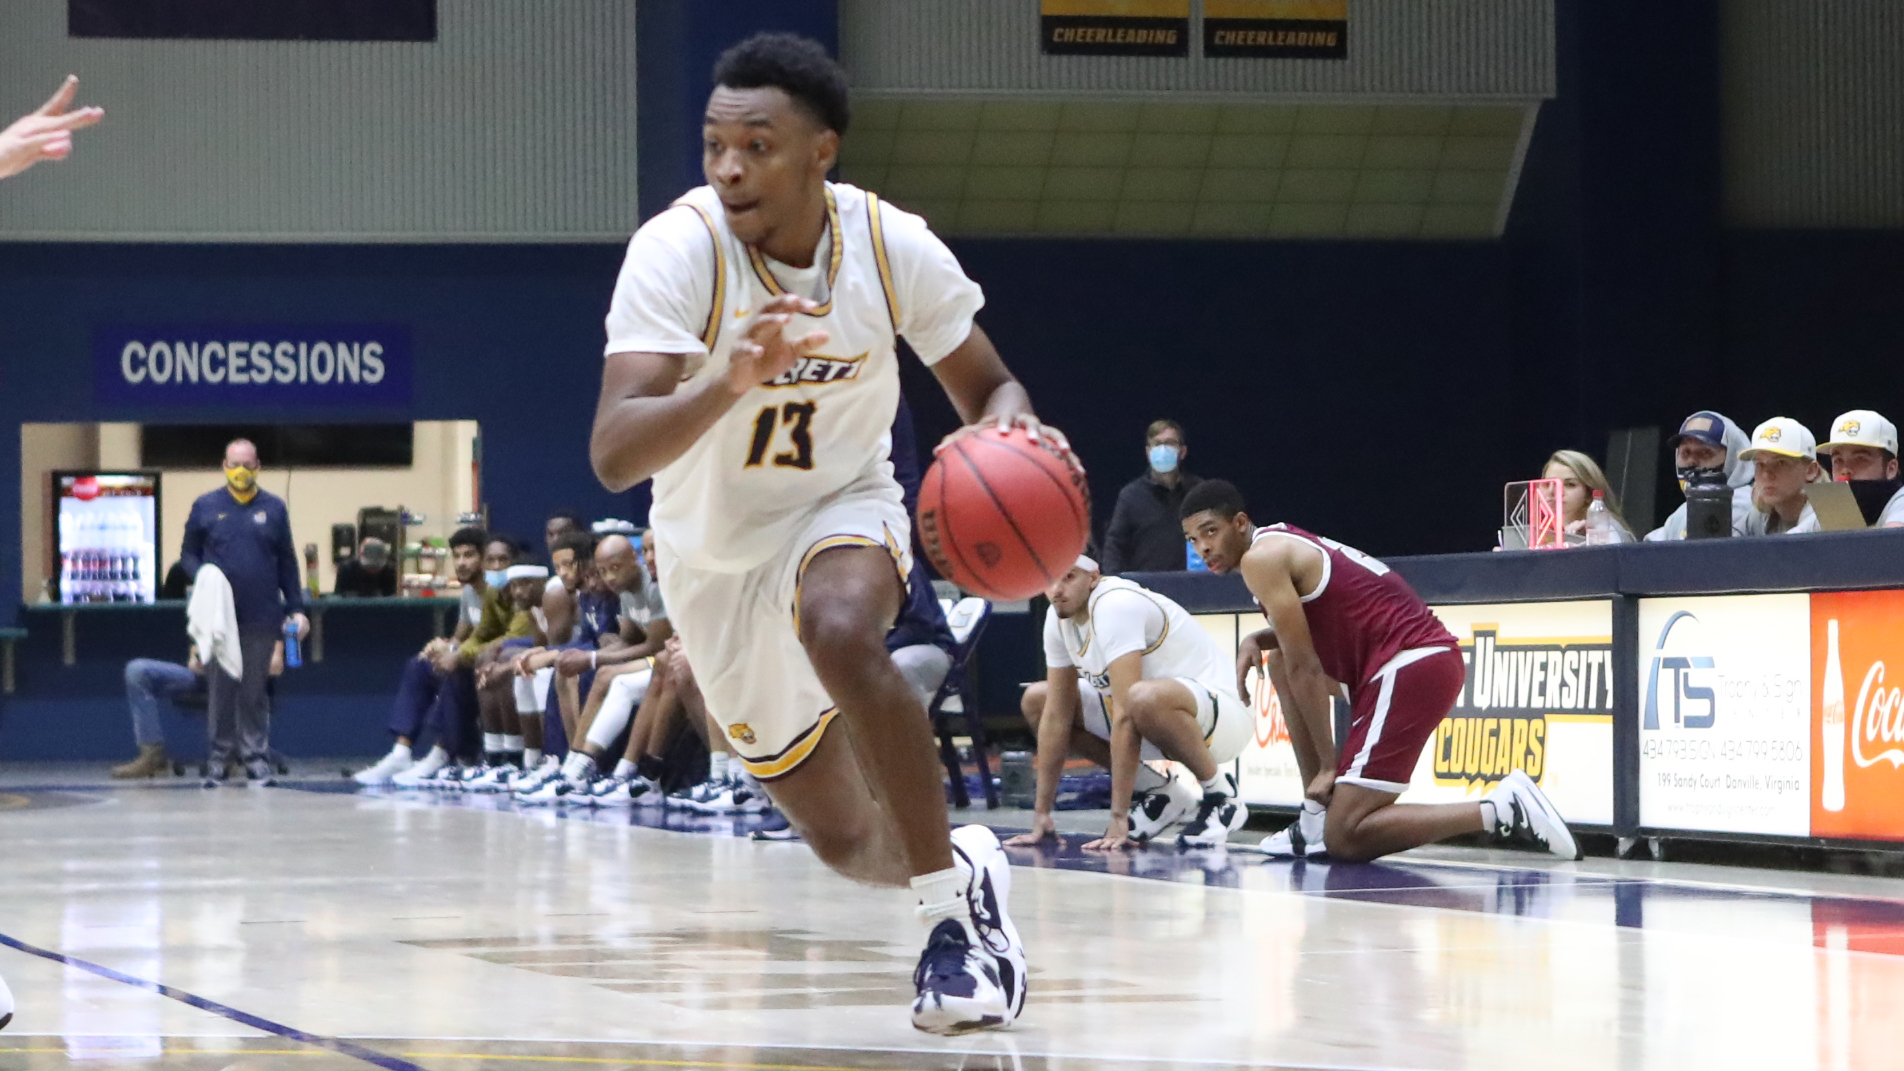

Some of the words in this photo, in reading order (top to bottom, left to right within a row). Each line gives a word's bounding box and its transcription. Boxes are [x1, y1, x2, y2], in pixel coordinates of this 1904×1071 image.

[1053, 27, 1177, 44] CHEERLEADING
[1214, 30, 1338, 47] CHEERLEADING
[121, 340, 386, 384] CONCESSIONS
[744, 398, 818, 470] 13
[1773, 673, 1803, 704] Sgn
[1434, 717, 1546, 777] COUGARS
[1771, 740, 1803, 761] 5806
[1657, 772, 1671, 788] 199
[1673, 772, 1697, 792] Sandy
[1699, 773, 1721, 790] Court
[1725, 774, 1762, 791] Danville,
[1764, 775, 1800, 795] Virginia
